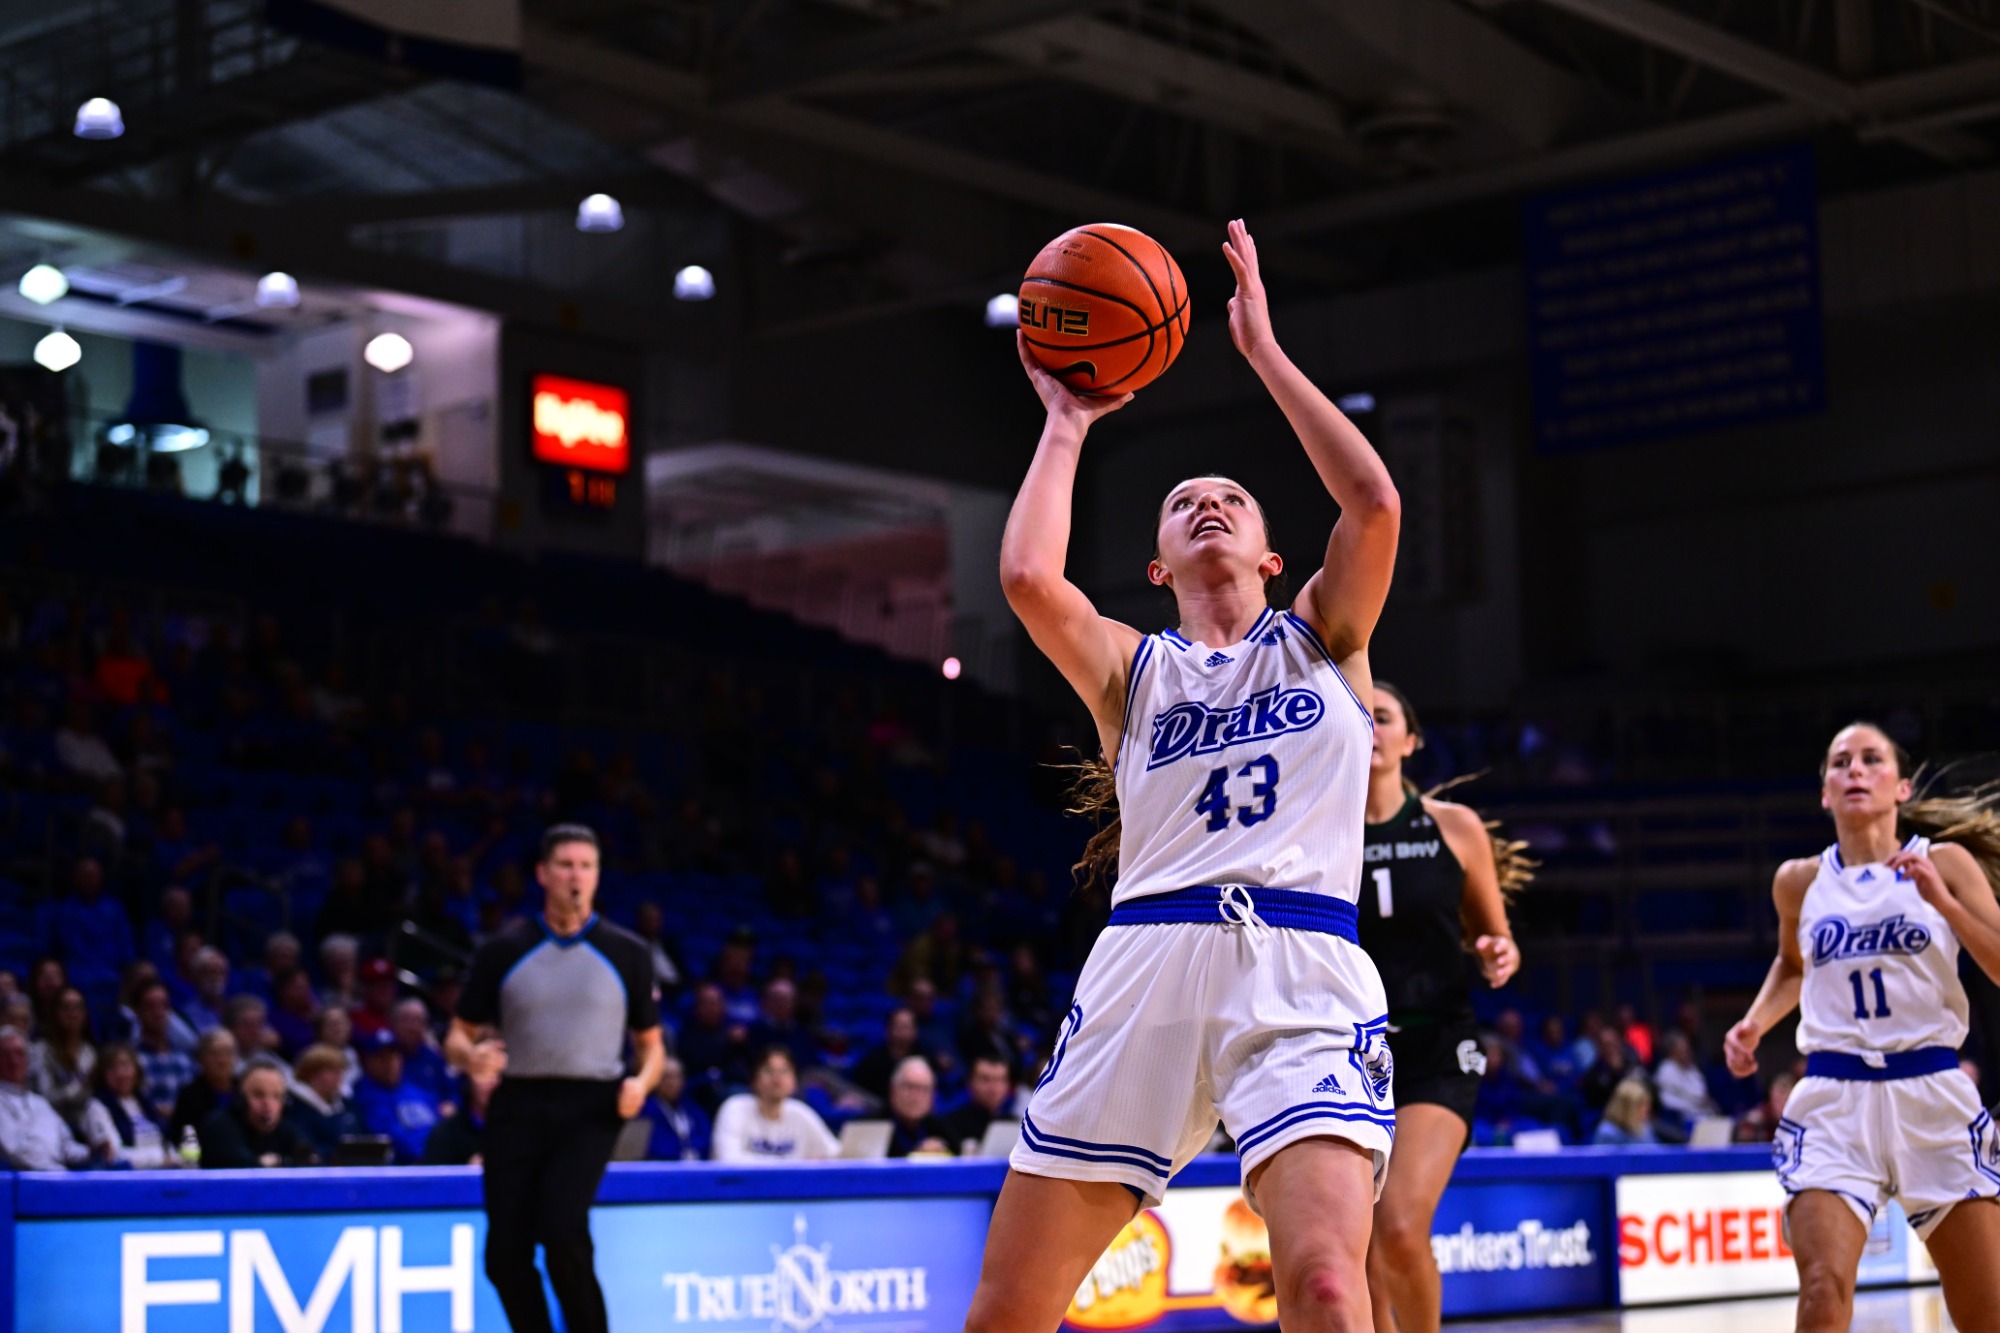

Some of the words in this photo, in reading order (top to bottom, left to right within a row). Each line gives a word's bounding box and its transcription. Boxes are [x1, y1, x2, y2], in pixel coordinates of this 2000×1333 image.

[1147, 683, 1325, 771] Drake
[1195, 753, 1280, 833] 43
[1371, 867, 1394, 919] 1
[1811, 915, 1931, 966] Drake
[1848, 968, 1892, 1020] 11
[1311, 1083, 1347, 1096] adidas
[1617, 1207, 1795, 1267] SCHEEL
